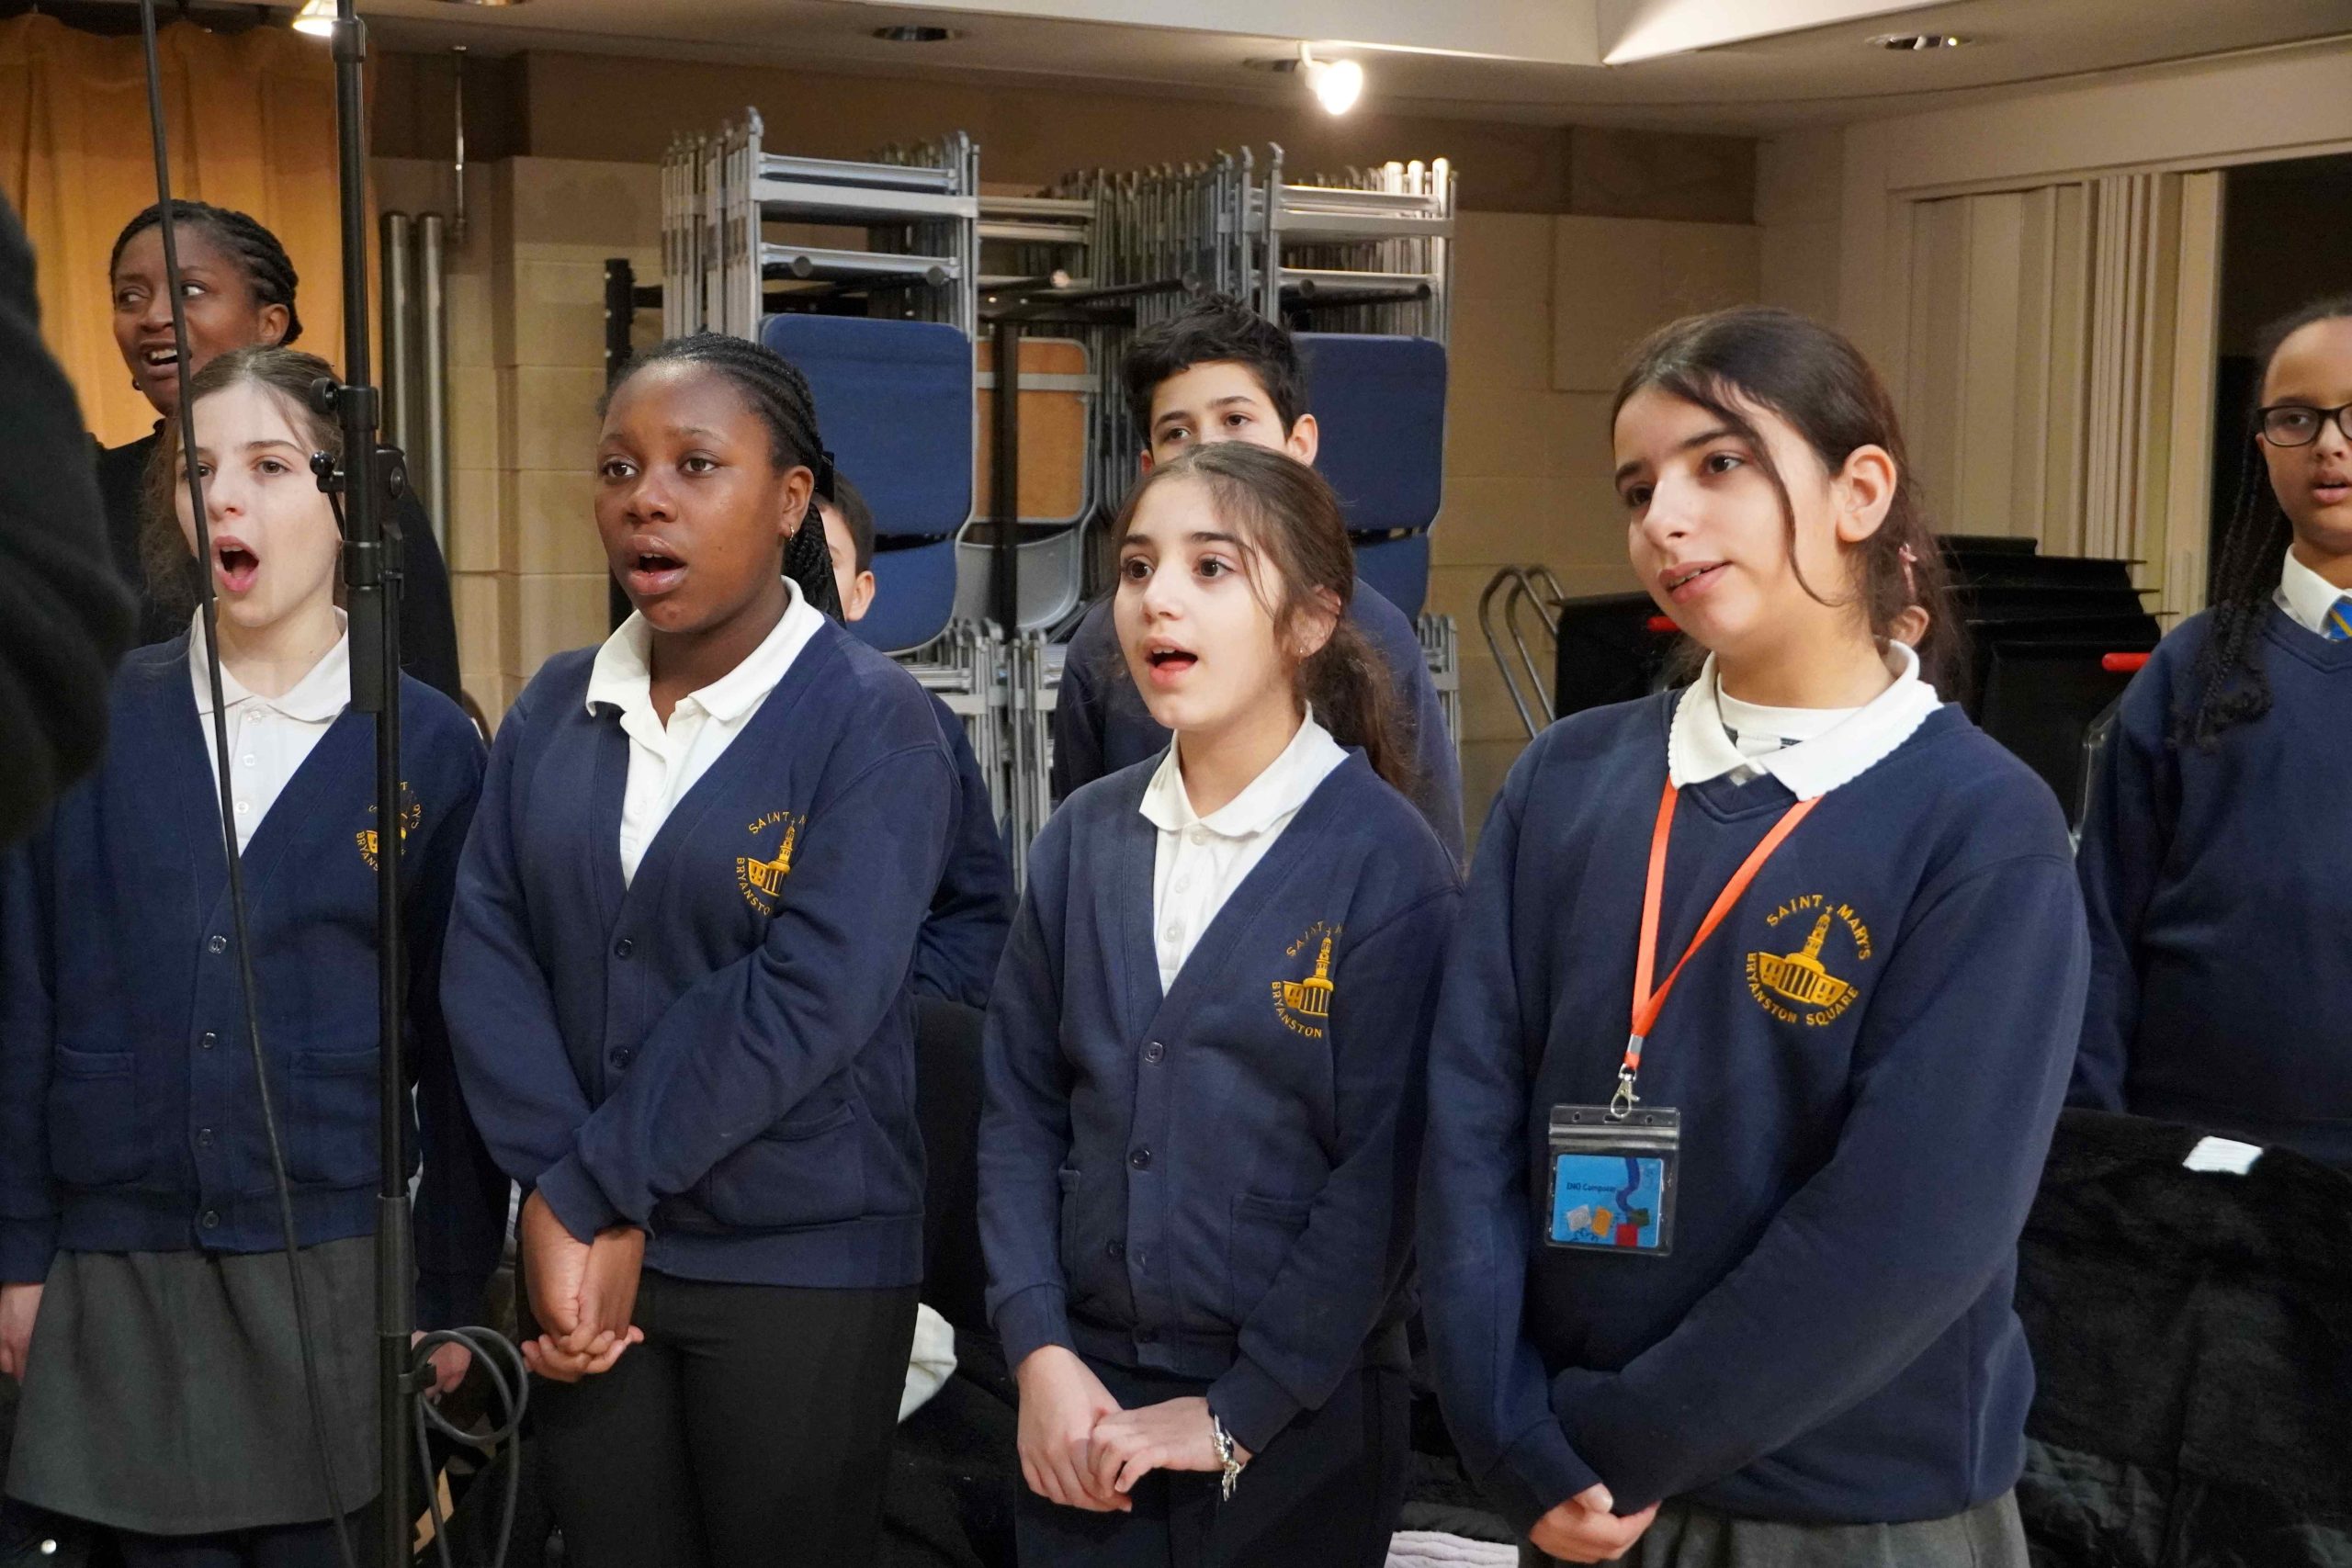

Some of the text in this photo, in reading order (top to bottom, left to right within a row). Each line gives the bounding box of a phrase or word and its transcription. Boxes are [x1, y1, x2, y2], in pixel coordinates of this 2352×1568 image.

[356, 830, 379, 872] BRYANS
[748, 811, 790, 835] SAINT
[736, 857, 771, 916] BRYANSTO
[1766, 894, 1871, 961] SAINT MARY'S
[1272, 980, 1323, 1039] BRYANSTON
[1745, 952, 1860, 1026] BRYANSTON SQUARE
